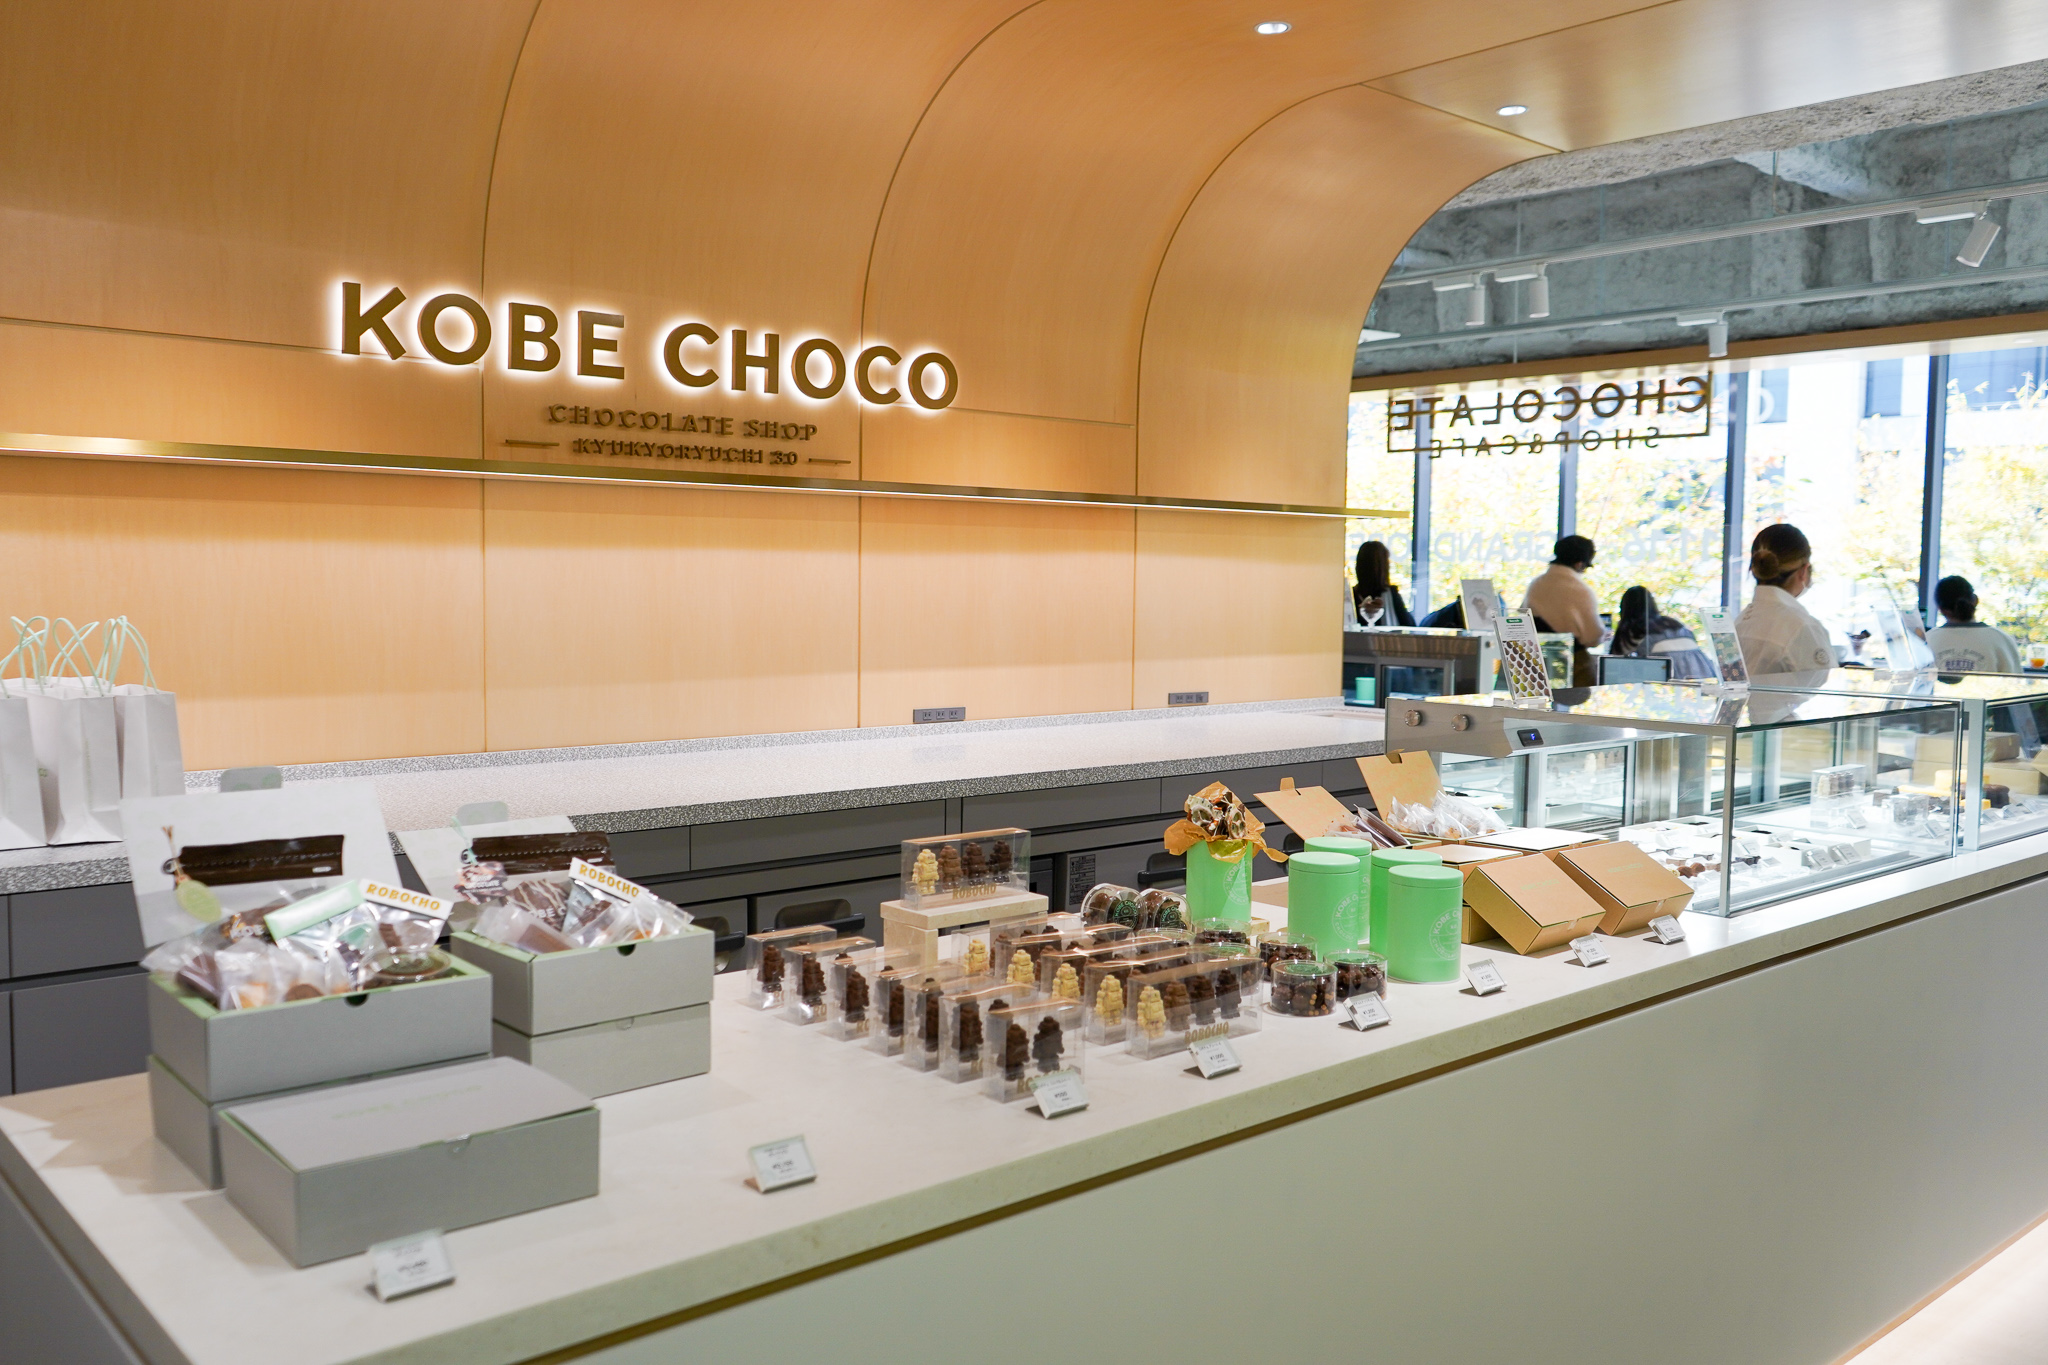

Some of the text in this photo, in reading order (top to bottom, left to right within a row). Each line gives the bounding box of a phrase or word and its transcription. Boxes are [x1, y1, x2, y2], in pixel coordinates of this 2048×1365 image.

[342, 281, 958, 409] KOBE CHOCO
[549, 403, 818, 441] CHOCOLATE SHOP
[573, 437, 798, 466] KYUKYORYUCHI 30
[579, 863, 640, 898] ROBOCHO
[366, 883, 441, 911] ROBOCHO
[1184, 1021, 1230, 1044] ROBOCHO
